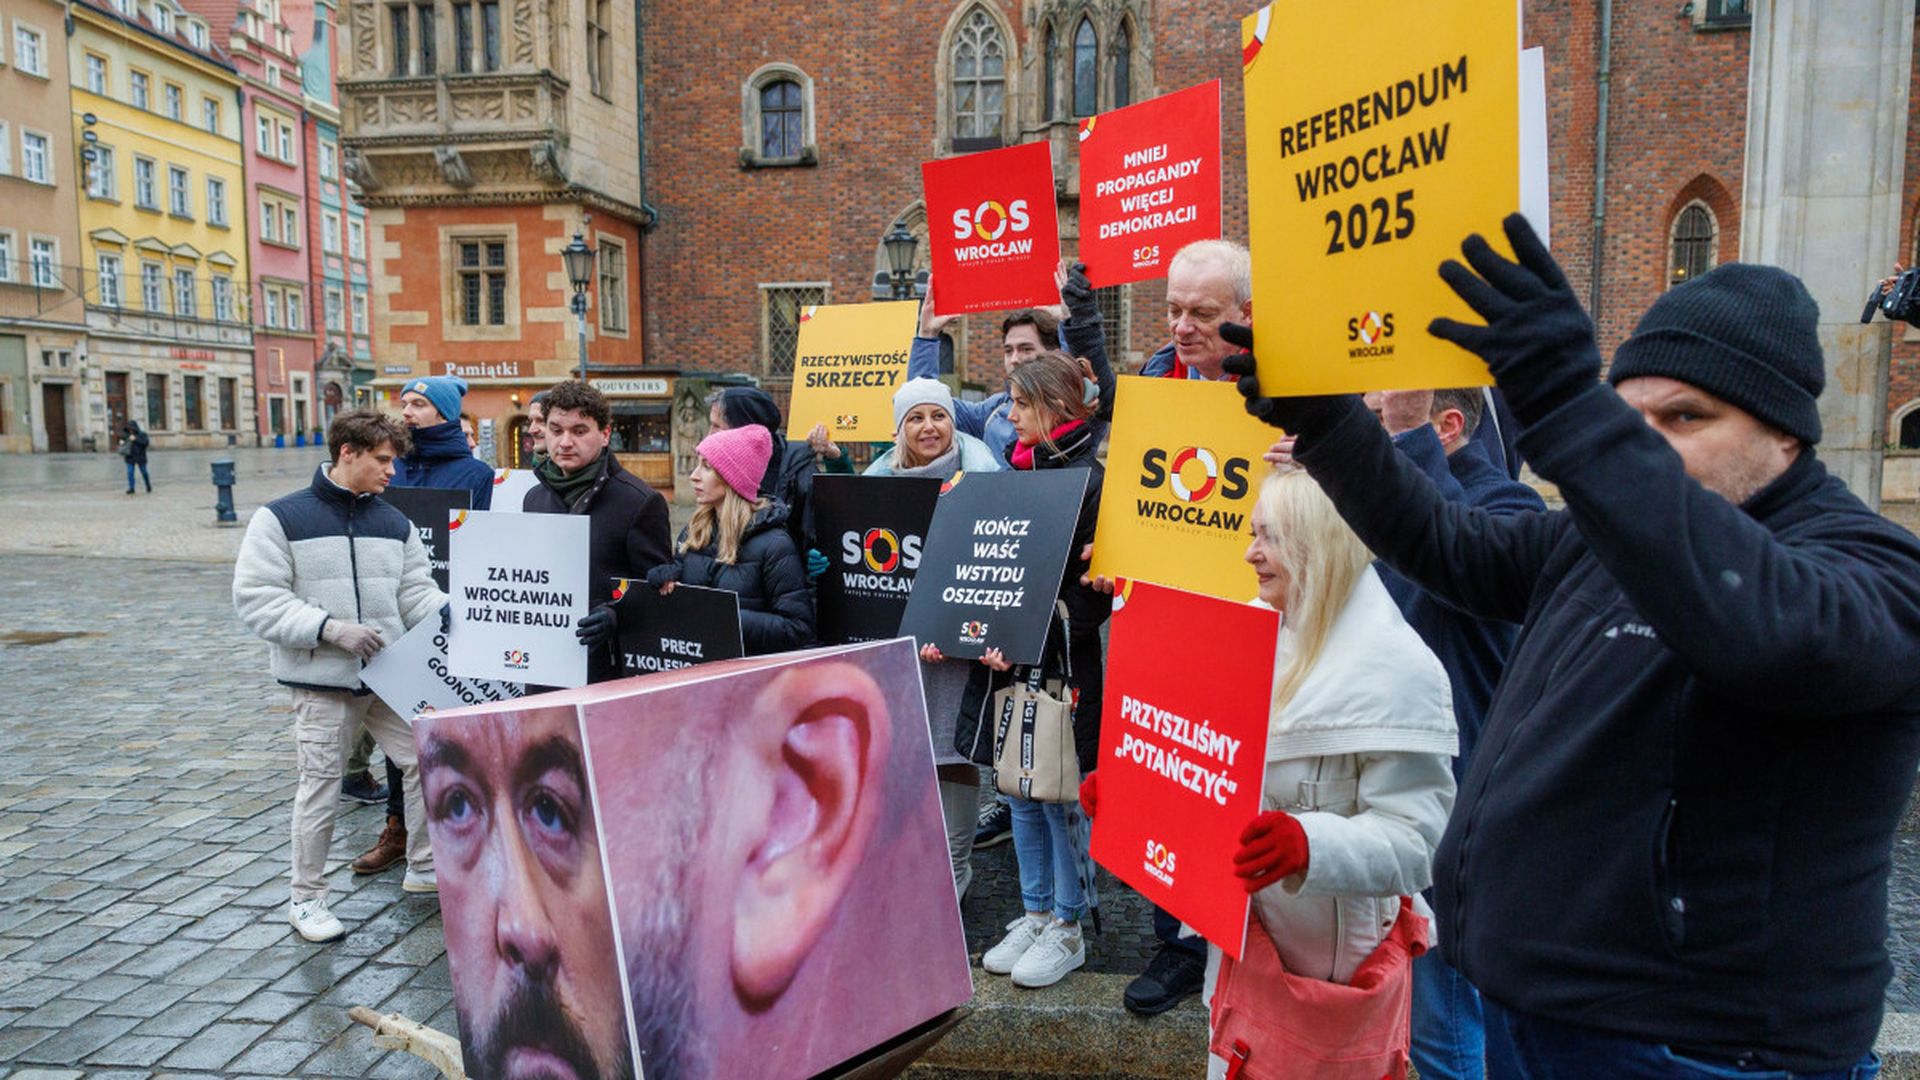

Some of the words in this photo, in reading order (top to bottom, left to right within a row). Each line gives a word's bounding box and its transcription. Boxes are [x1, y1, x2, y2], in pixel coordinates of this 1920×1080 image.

[1280, 55, 1468, 159] REFERENDUM
[1123, 144, 1167, 169] MNIEJ
[1295, 122, 1450, 202] WROCŁAW
[1096, 157, 1202, 198] PROPAGANDY
[1120, 187, 1173, 213] WIĘCEJ
[953, 199, 1030, 241] SOS
[1099, 205, 1196, 240] DEMOKRACJI
[1325, 189, 1415, 256] 2025
[954, 238, 1033, 262] WROCŁAW
[1133, 246, 1159, 261] SOS
[1348, 311, 1394, 344] SOS
[445, 361, 519, 378] Pamiątki
[801, 350, 908, 367] RZECZYWISTOŚĆ
[805, 370, 899, 388] SKRZECZY
[836, 415, 858, 427] SOS
[1140, 445, 1250, 503] SOS
[973, 516, 1031, 536] KOŃCZ
[1137, 499, 1244, 531] WROCŁAW
[841, 527, 922, 574] SOS
[973, 539, 1020, 560] WAŚĆ
[488, 567, 508, 582] ZA
[512, 569, 549, 584] HAJS
[955, 565, 1025, 584] WSTYDU
[464, 586, 573, 607] WROCŁAWIAN
[942, 586, 1025, 611] OSZCZĘDŹ
[466, 605, 492, 622] JUŻ
[496, 609, 520, 625] NIE
[524, 612, 570, 628] BALUJ
[961, 621, 988, 637] SOS
[504, 650, 530, 663] SOS
[660, 637, 704, 658] PRECZ
[624, 653, 635, 668] Z
[1120, 695, 1240, 767] PRZYSZLIŚMY
[1146, 840, 1176, 872] SOS
